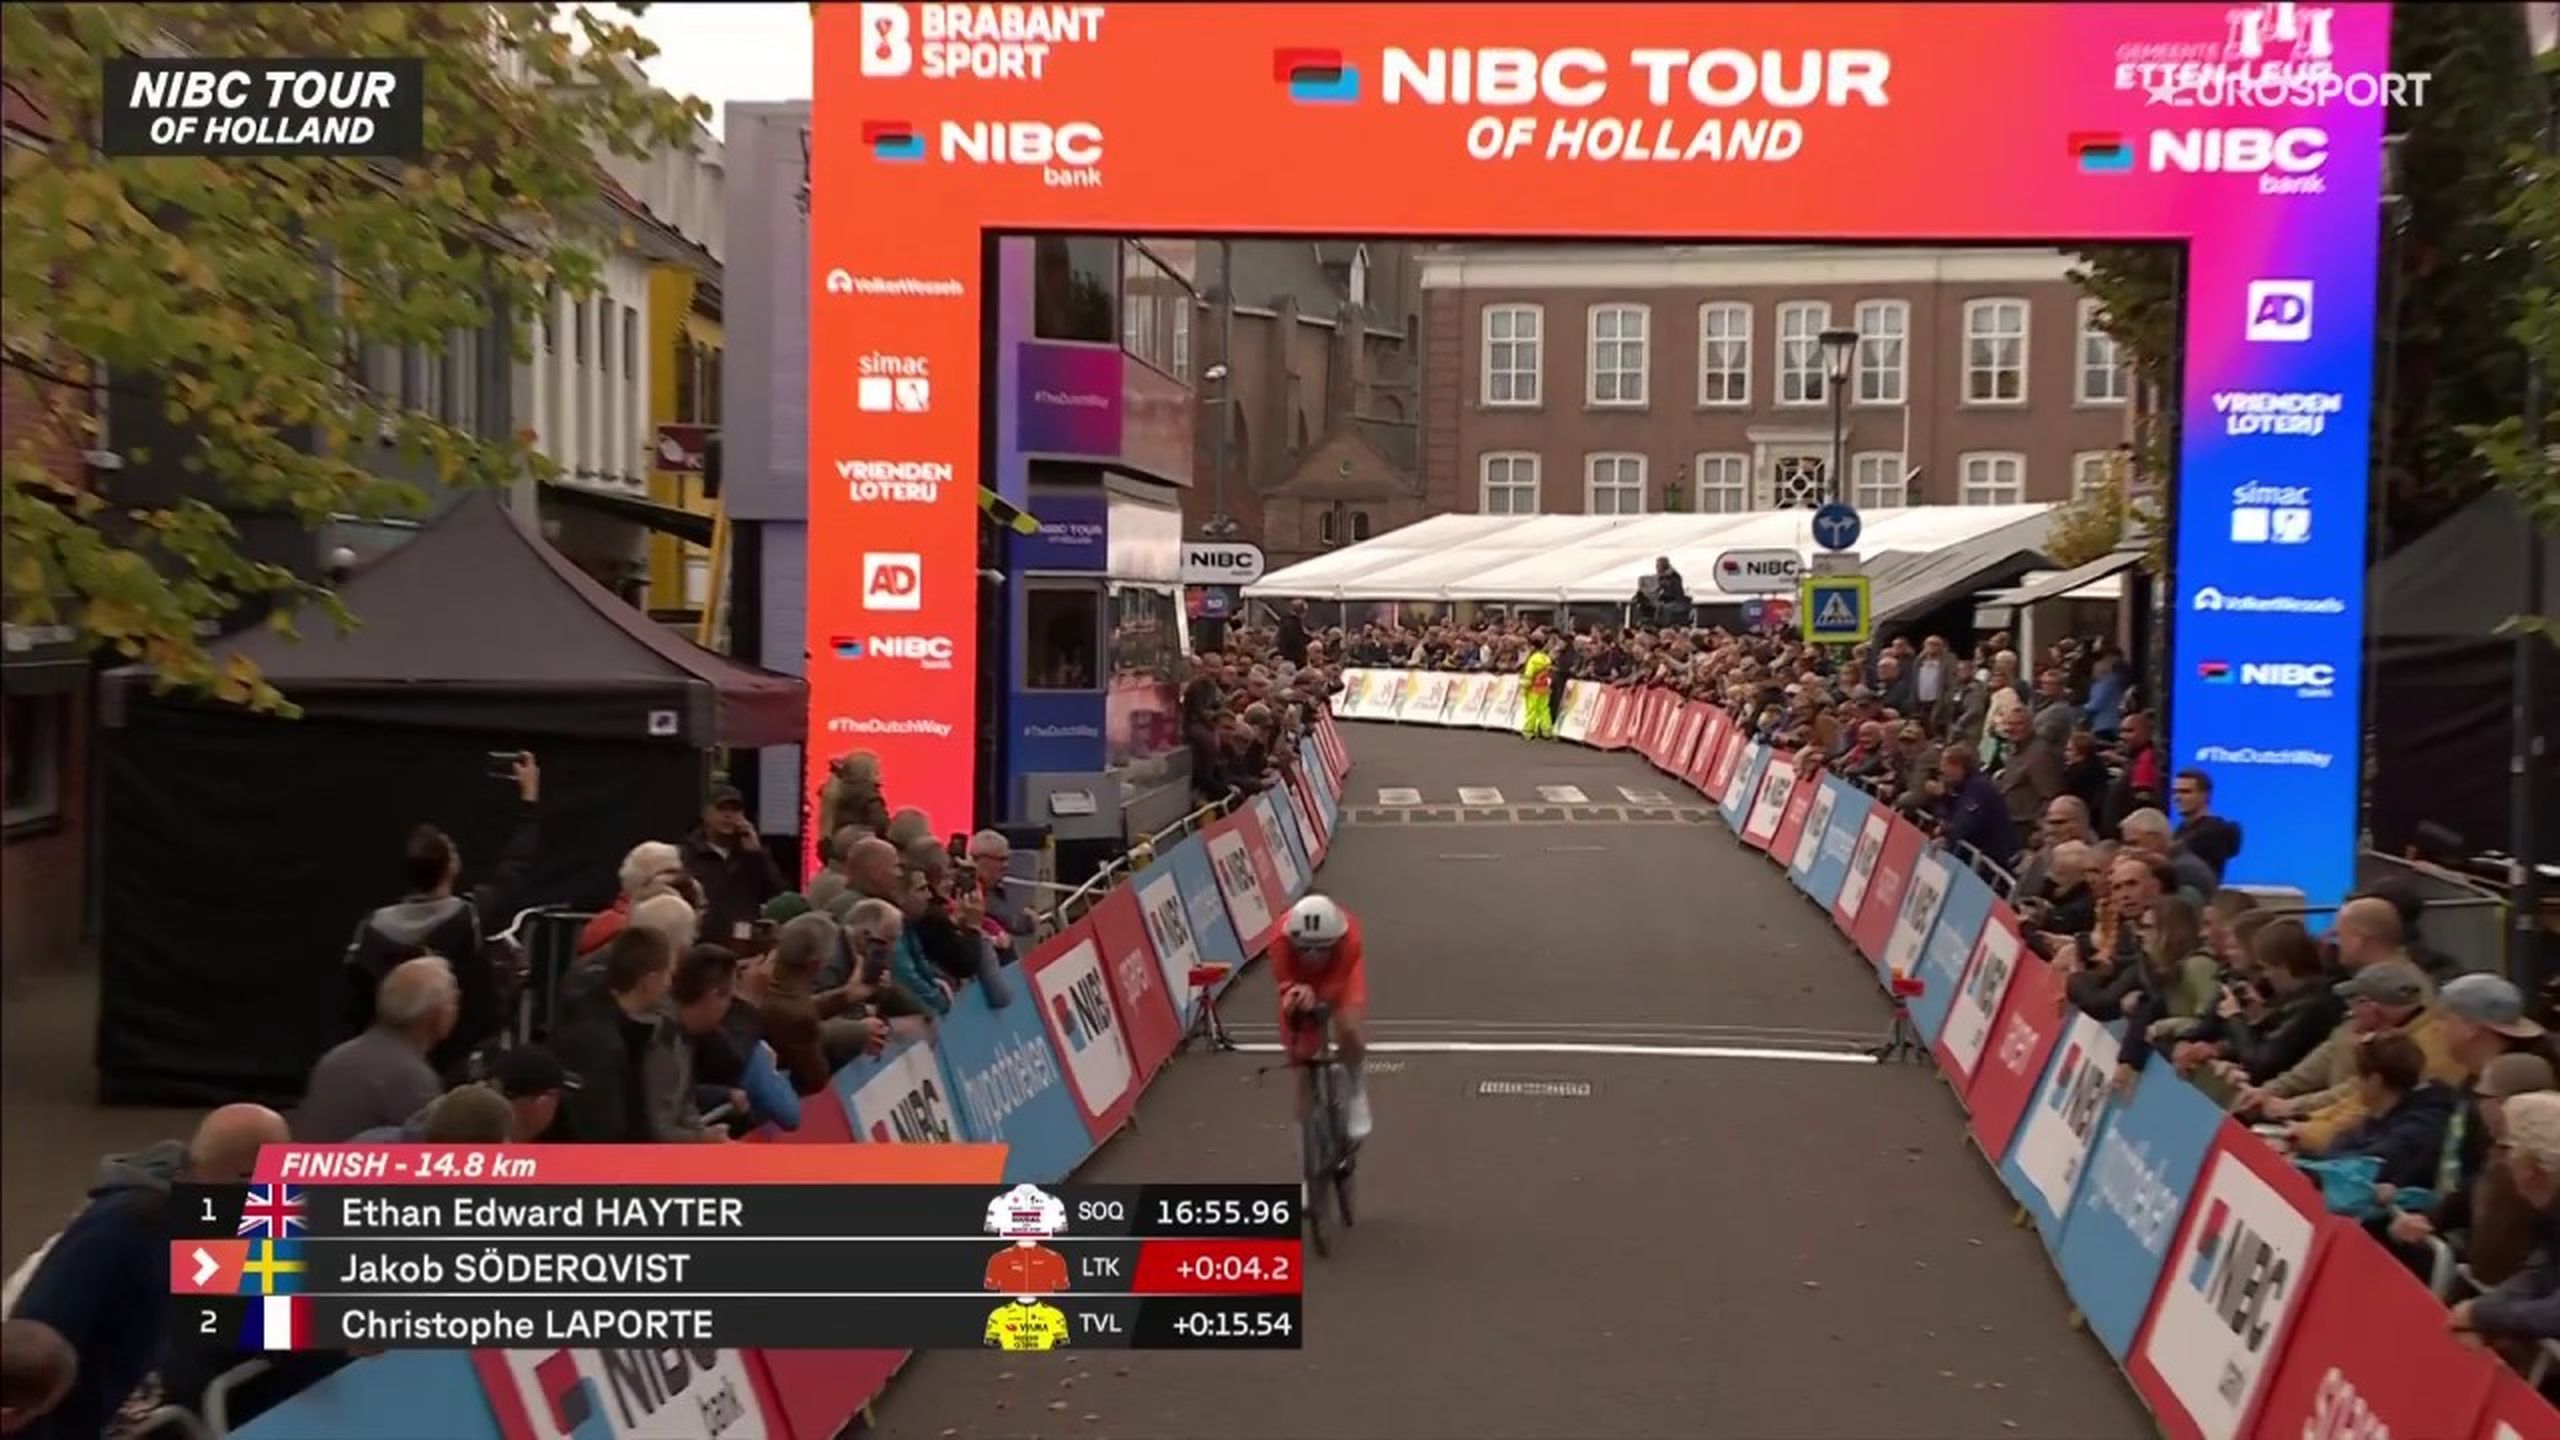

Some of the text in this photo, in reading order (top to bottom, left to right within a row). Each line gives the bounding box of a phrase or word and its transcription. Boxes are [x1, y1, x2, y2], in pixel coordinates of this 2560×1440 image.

[922, 4, 1104, 42] BRABANT
[922, 43, 1049, 79] SPORT
[1382, 47, 1891, 106] NIBC TOUR
[940, 120, 1103, 164] NIBC
[1467, 117, 1803, 161] OF HOLLAND
[2150, 128, 2329, 172] NIBC
[1044, 166, 1101, 187] bank
[2259, 174, 2325, 194] bank
[2255, 294, 2305, 325] AD
[859, 352, 928, 375] simac
[836, 461, 952, 481] VRIENDEN
[2232, 480, 2311, 506] simac
[1190, 552, 1254, 568] NIBC
[1746, 560, 1796, 575] NIBC
[869, 565, 916, 596] AD
[869, 635, 953, 659] NIBC
[2240, 662, 2336, 685] NIBC
[828, 716, 951, 737] #TheDutchWay
